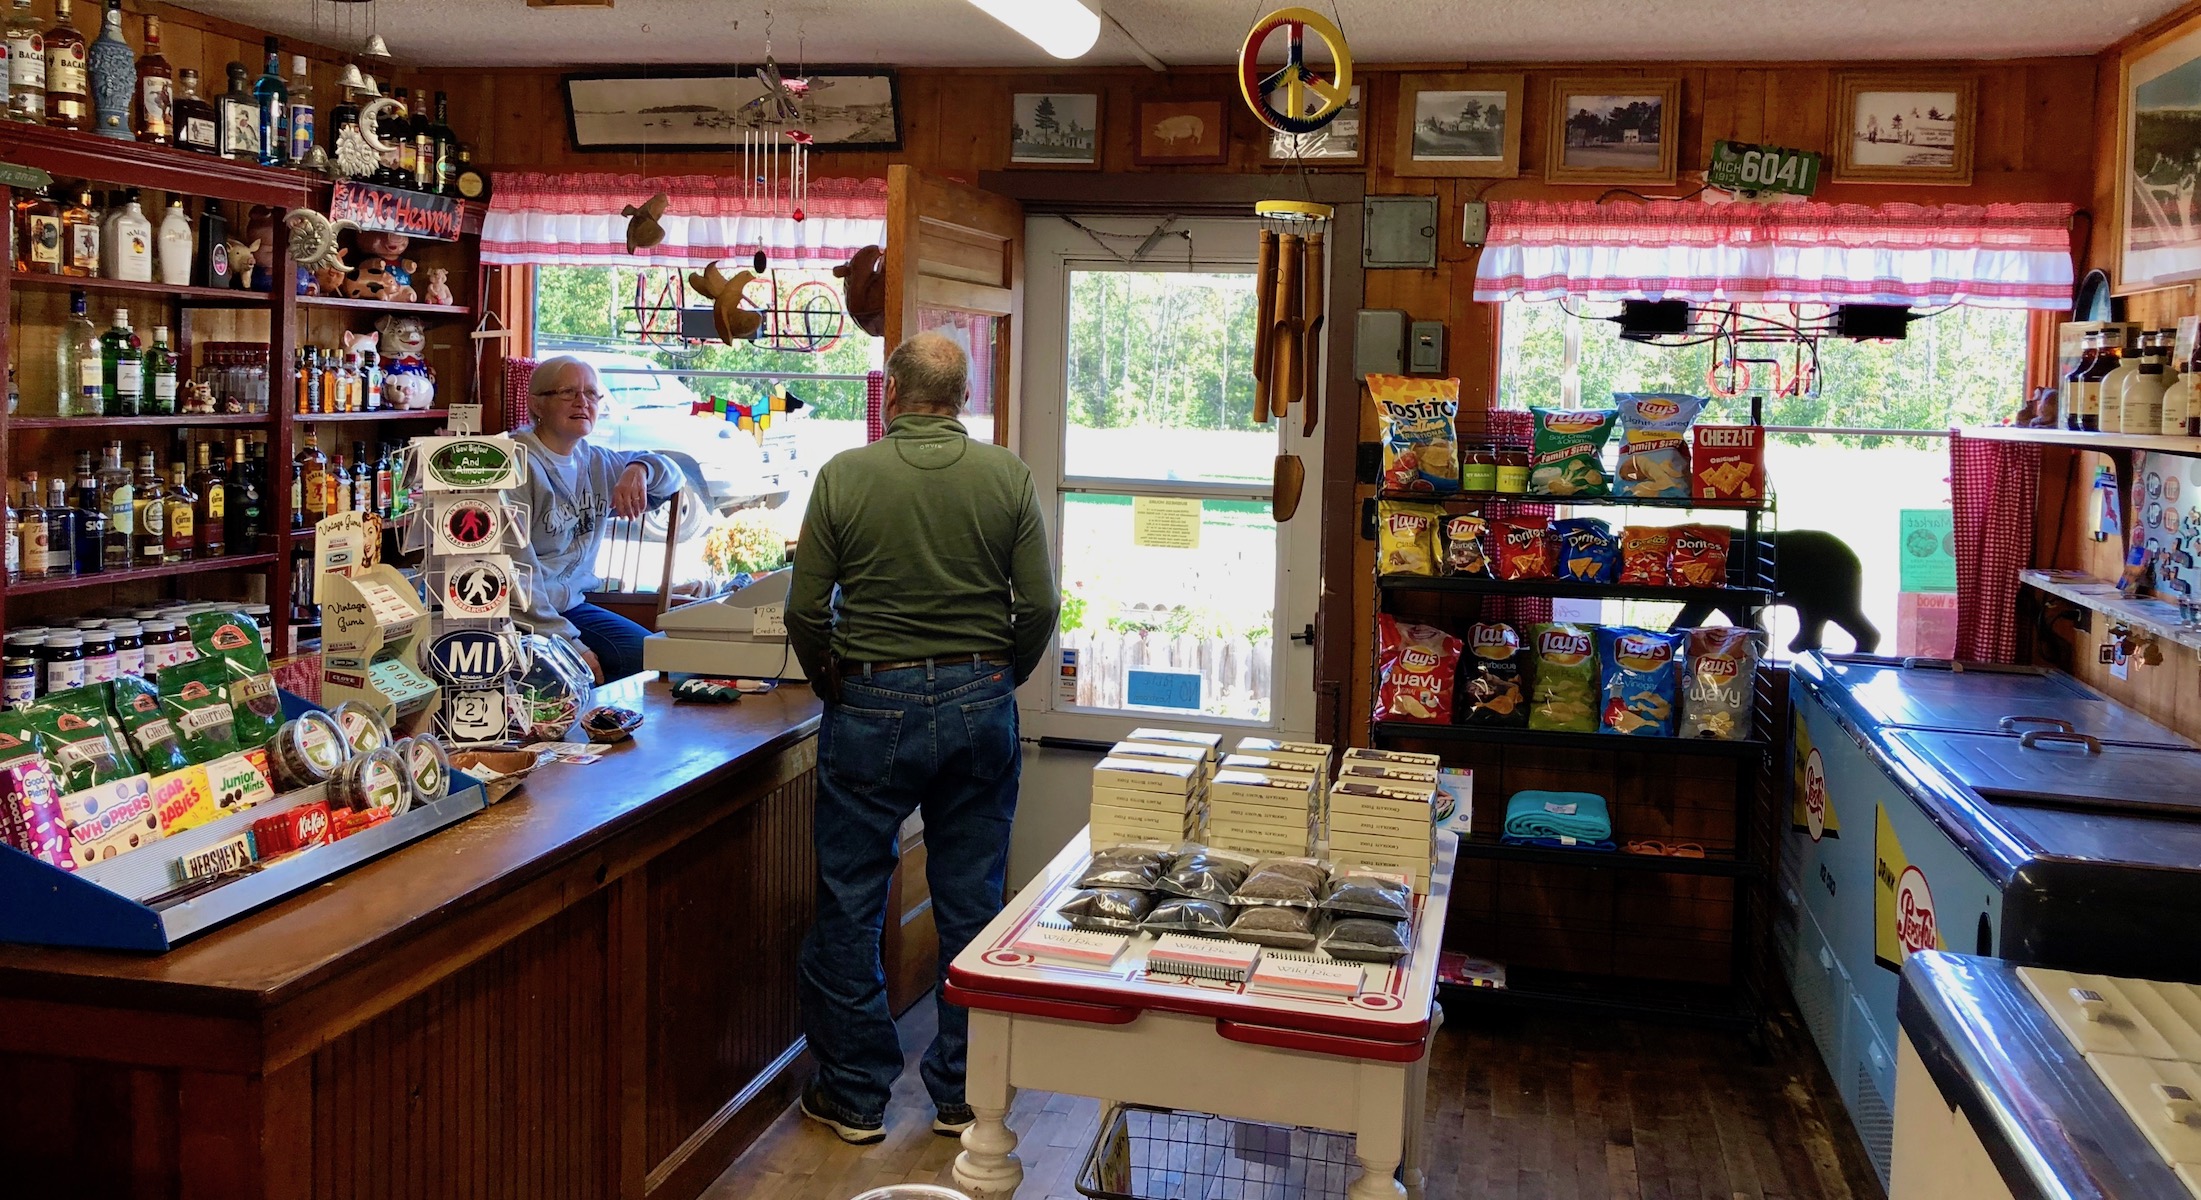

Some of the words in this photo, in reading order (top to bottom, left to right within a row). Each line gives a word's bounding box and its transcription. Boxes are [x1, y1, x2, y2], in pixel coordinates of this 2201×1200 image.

[1713, 160, 1741, 174] MICH
[1740, 151, 1810, 190] 6041
[394, 196, 453, 234] Heaven
[461, 457, 480, 466] And
[1541, 449, 1570, 463] Family
[456, 500, 483, 512] SEARCH
[484, 505, 492, 514] OF
[447, 533, 465, 546] SASSY
[466, 530, 495, 547] SQUATCH
[1677, 538, 1722, 550] Doritos
[327, 602, 367, 614] Vintage
[337, 616, 365, 632] Gums
[755, 627, 777, 635] Credit
[449, 641, 496, 674] MI
[332, 675, 355, 684] CLOVE
[1391, 672, 1442, 694] wavy
[465, 702, 476, 716] 2
[24, 775, 44, 788] Good
[220, 769, 255, 792] Junior
[242, 779, 265, 795] Mints
[27, 788, 49, 799] Plenty
[74, 794, 151, 843] WHOPPERS
[189, 840, 247, 878] HERSHEY'S
